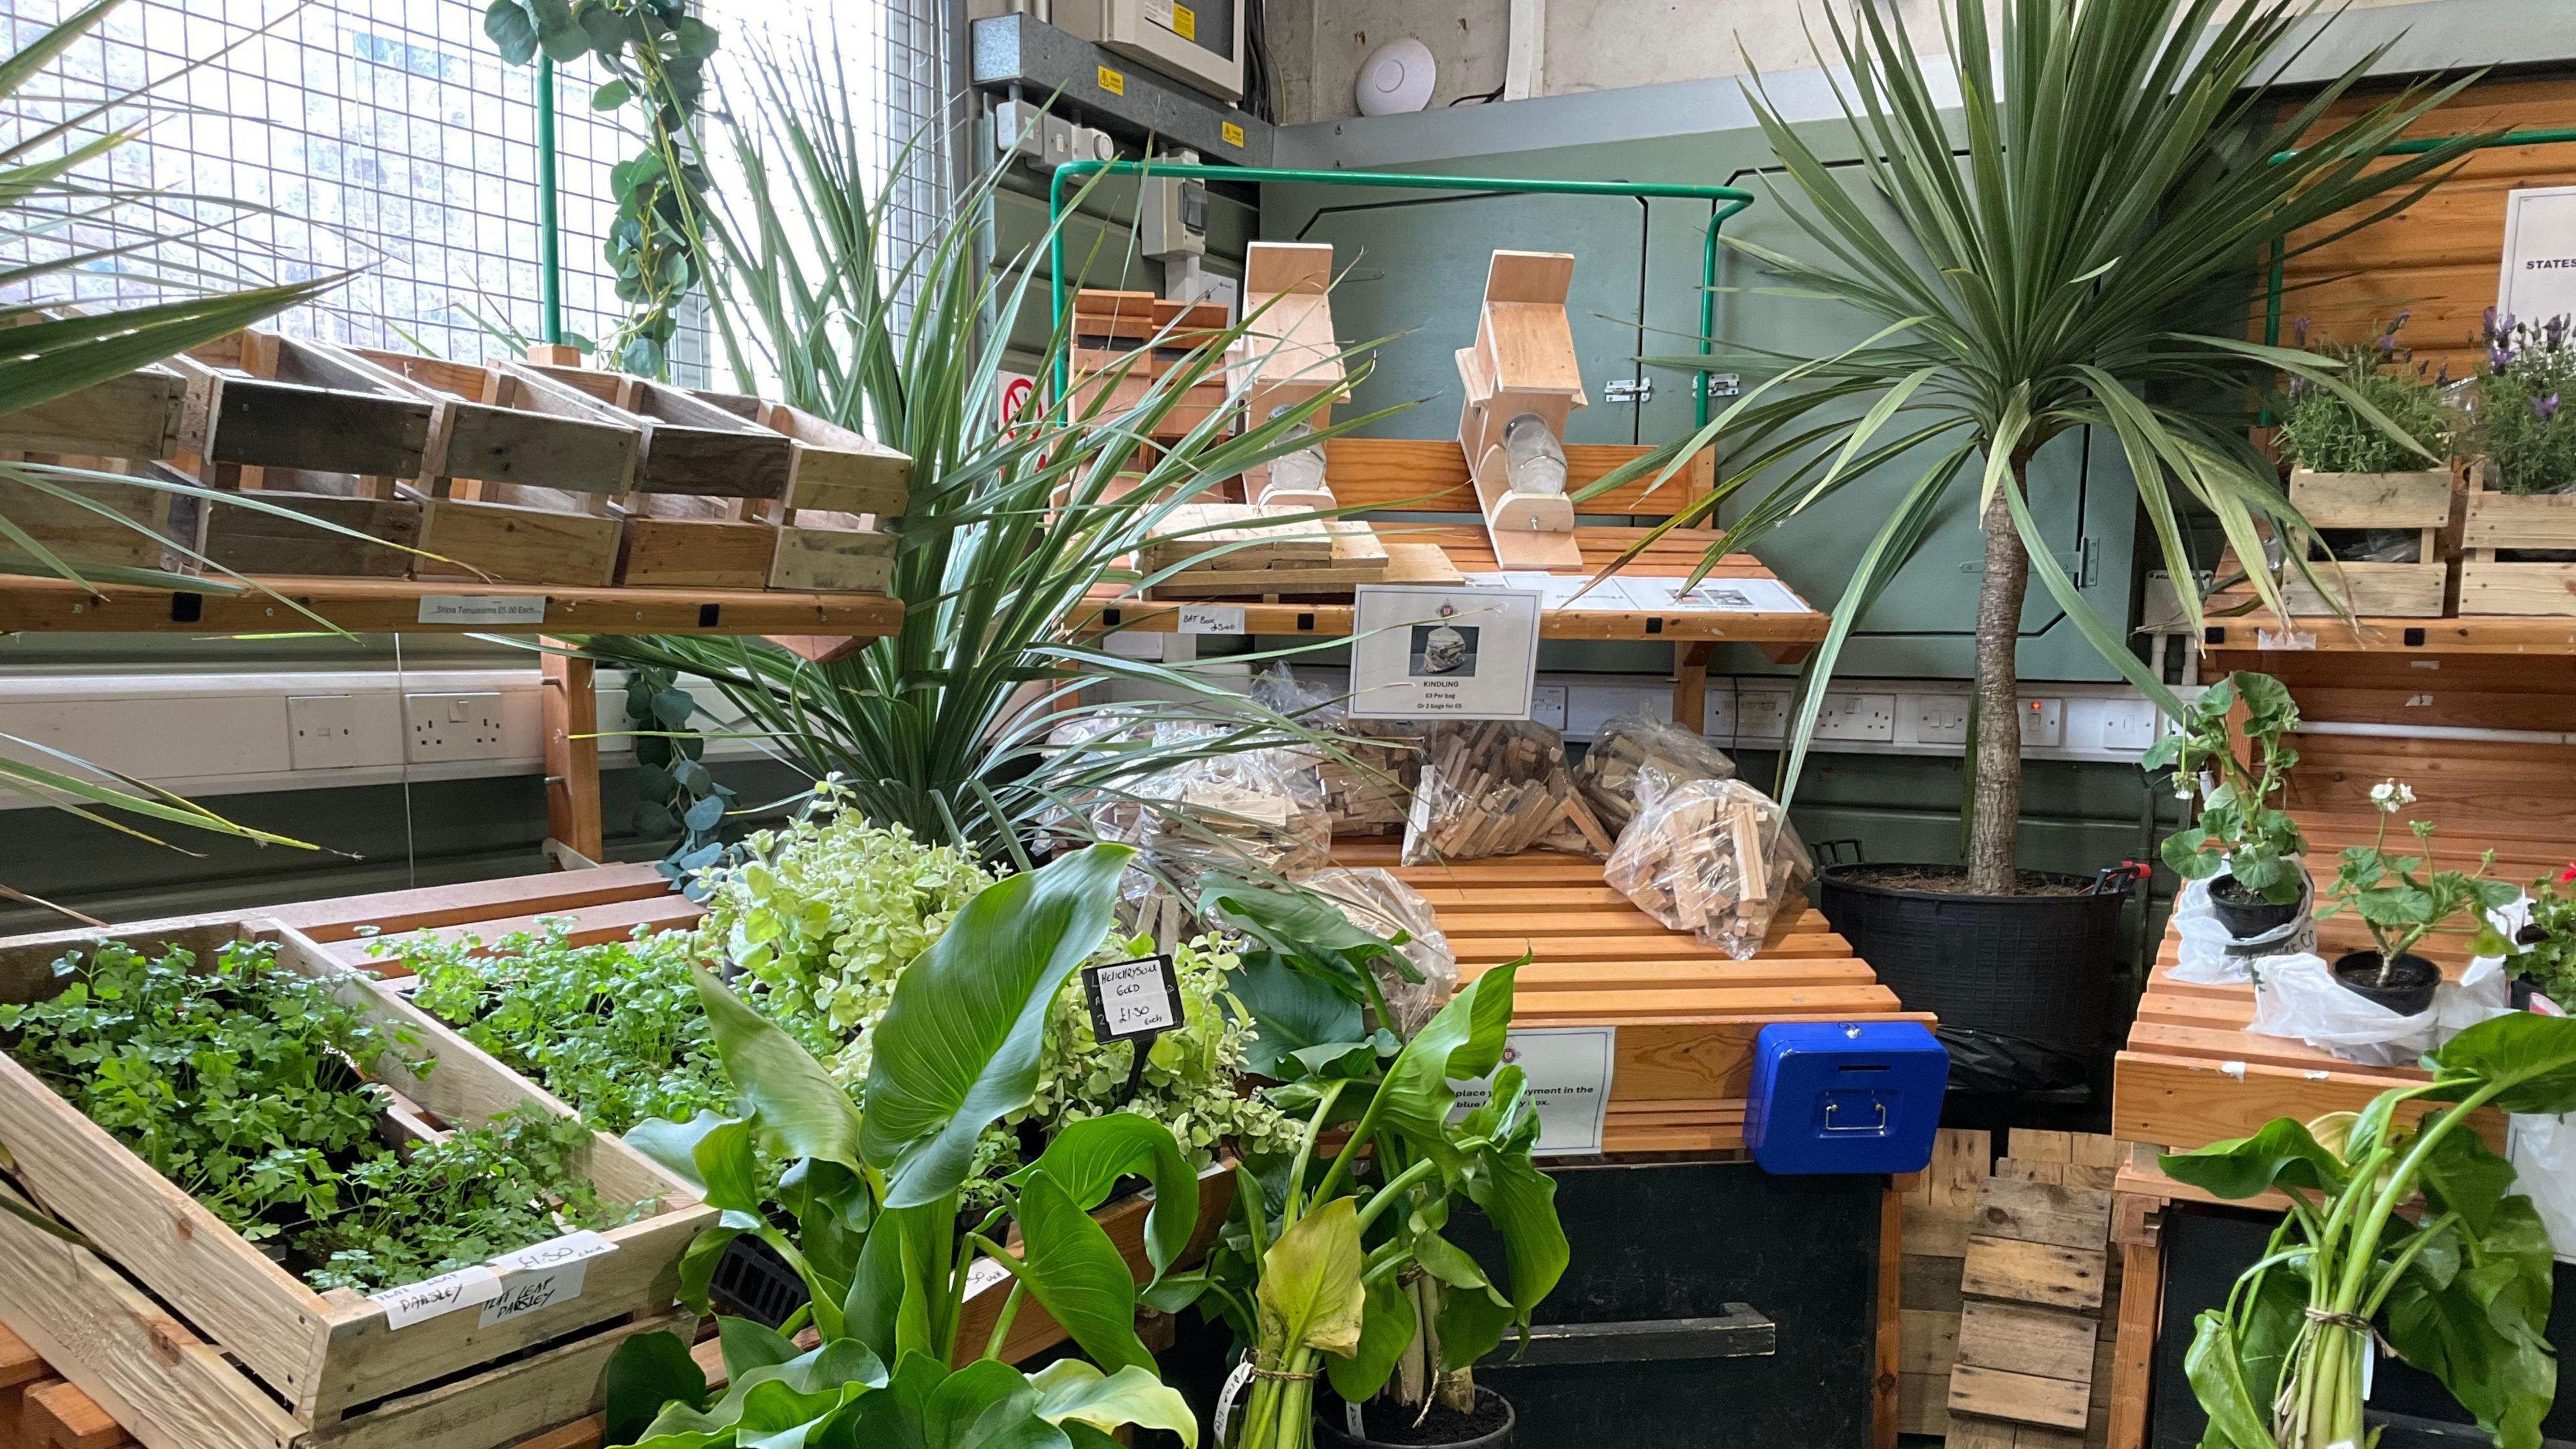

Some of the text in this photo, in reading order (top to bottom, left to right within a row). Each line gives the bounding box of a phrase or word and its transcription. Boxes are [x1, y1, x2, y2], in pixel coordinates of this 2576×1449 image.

[2526, 259, 2576, 270] STATES
[437, 606, 456, 614] Stipa
[1183, 614, 1199, 623] BAT
[1456, 1089, 1485, 1098] place
[1524, 1087, 1562, 1095] yment
